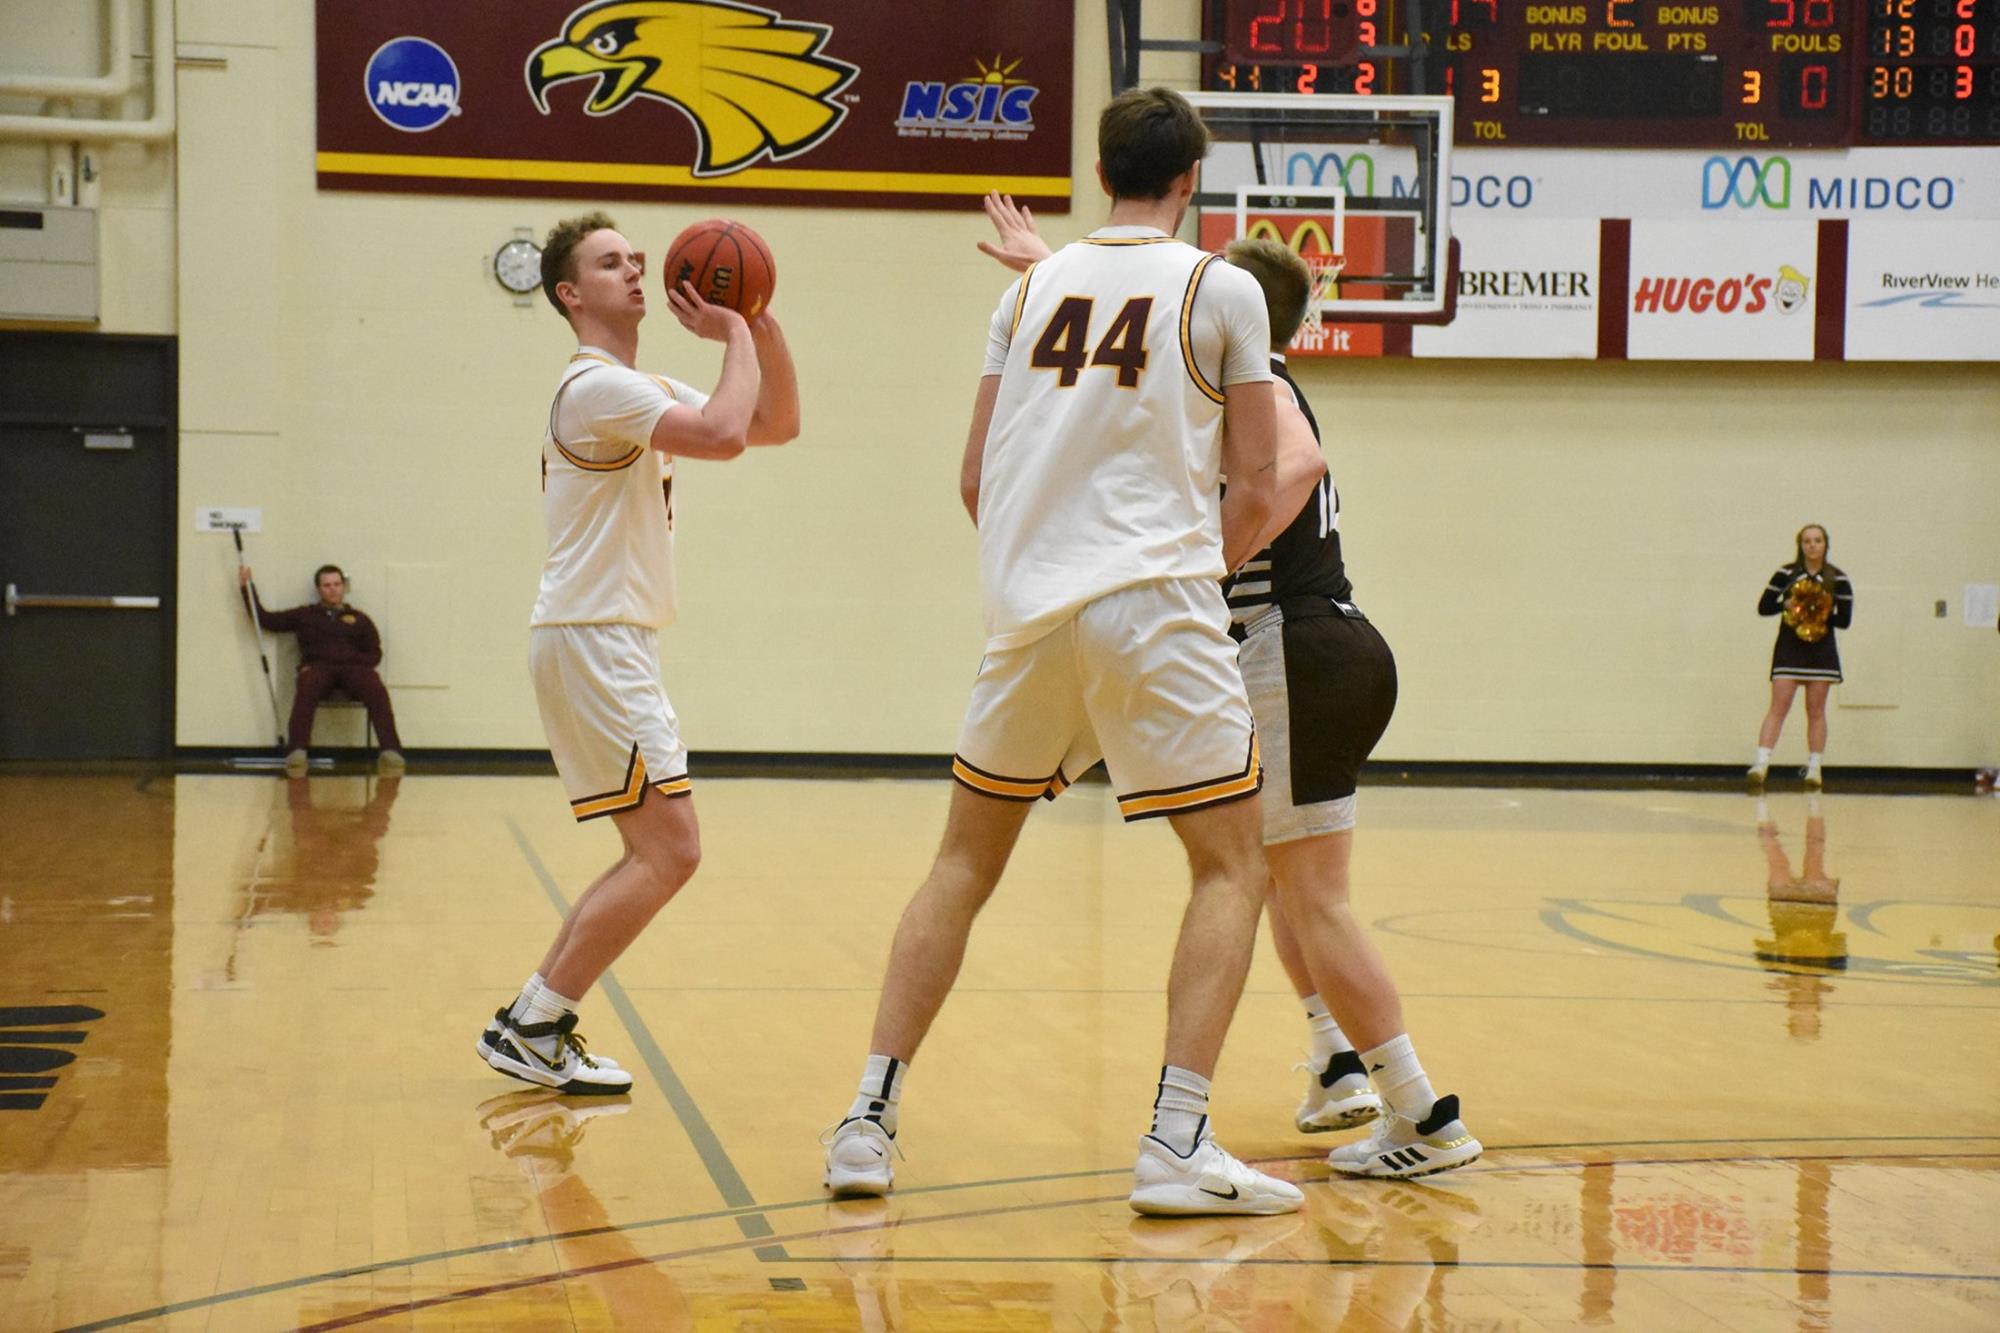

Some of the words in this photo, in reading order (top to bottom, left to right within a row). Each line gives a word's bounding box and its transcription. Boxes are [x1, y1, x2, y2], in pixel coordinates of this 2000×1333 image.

[1526, 6, 1586, 24] BONUS
[1658, 6, 1719, 25] BONUS
[1530, 32, 1582, 51] PLYR
[1594, 32, 1648, 51] FOUL
[1667, 32, 1707, 51] PTS
[1771, 34, 1842, 52] FOULS
[1885, 24, 1914, 57] 13
[1955, 24, 1975, 57] 0
[376, 81, 454, 108] NCAA
[1298, 64, 1317, 93] 2
[1355, 63, 1375, 95] 2
[1481, 69, 1500, 103] 3
[1742, 70, 1761, 104] 3
[1802, 65, 1828, 109] 0
[1873, 66, 1912, 98] 30
[1955, 65, 1973, 98] 3
[900, 81, 1040, 124] NSIC
[1473, 121, 1507, 139] TOL
[1735, 122, 1769, 140] TOL
[1392, 175, 1533, 208] MDCO
[1808, 177, 1954, 209] MIDCO
[1458, 271, 1591, 297] BREMER
[1634, 274, 1772, 314] HUGO'S
[1882, 273, 1970, 289] RiverView
[1029, 294, 1155, 389] 44
[1333, 328, 1350, 351] it
